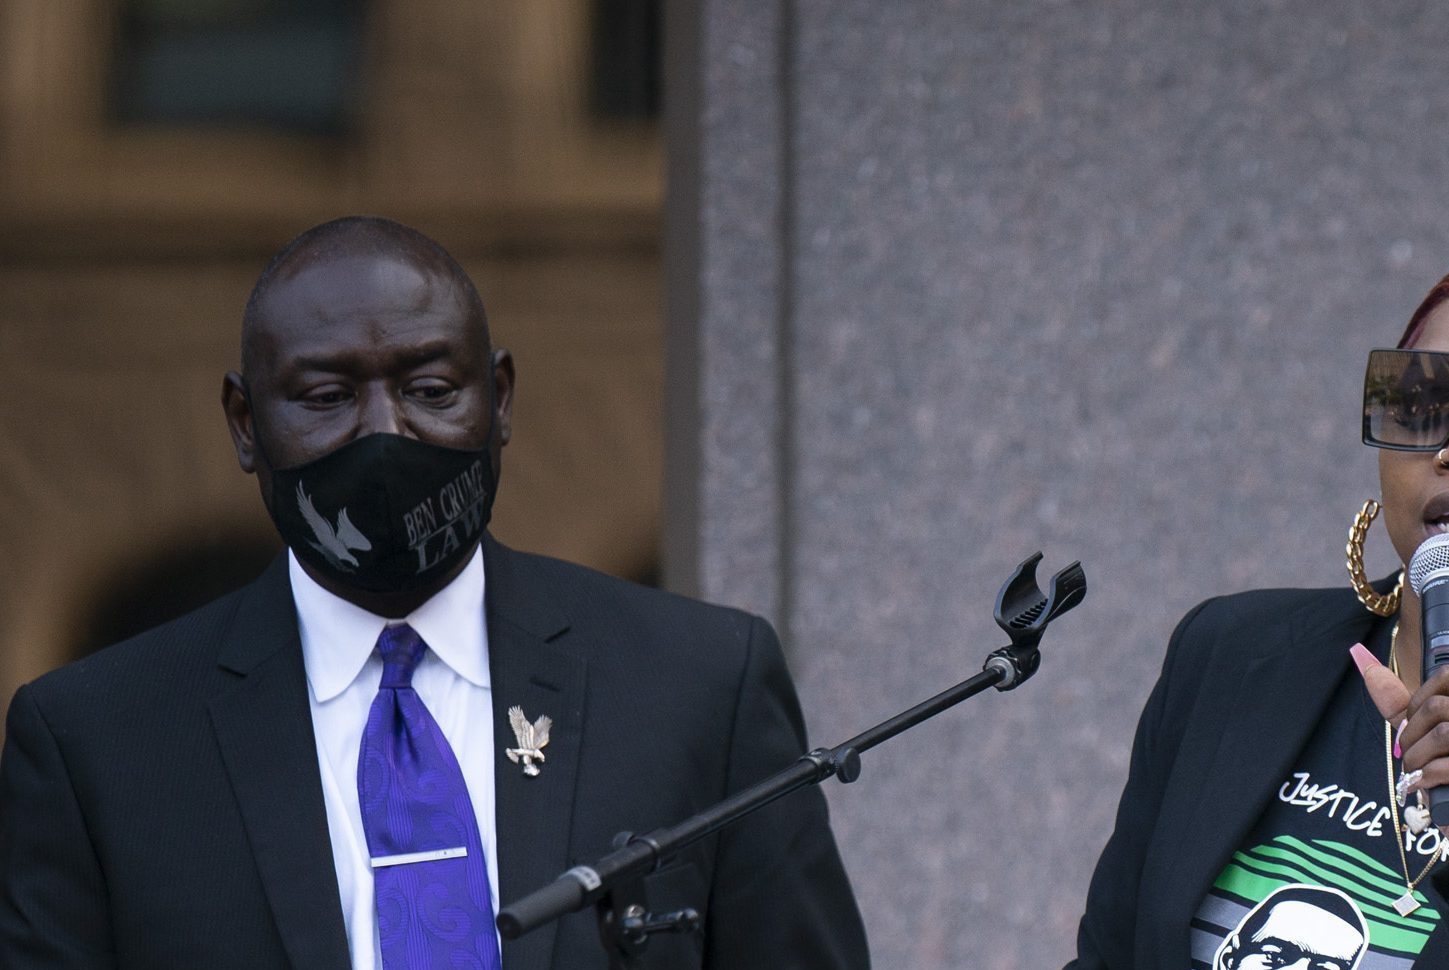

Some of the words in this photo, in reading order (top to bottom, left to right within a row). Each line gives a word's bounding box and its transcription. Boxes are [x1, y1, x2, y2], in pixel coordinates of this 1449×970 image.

[403, 497, 437, 546] BEN
[439, 459, 485, 521] CRUMP
[415, 496, 485, 575] LAW
